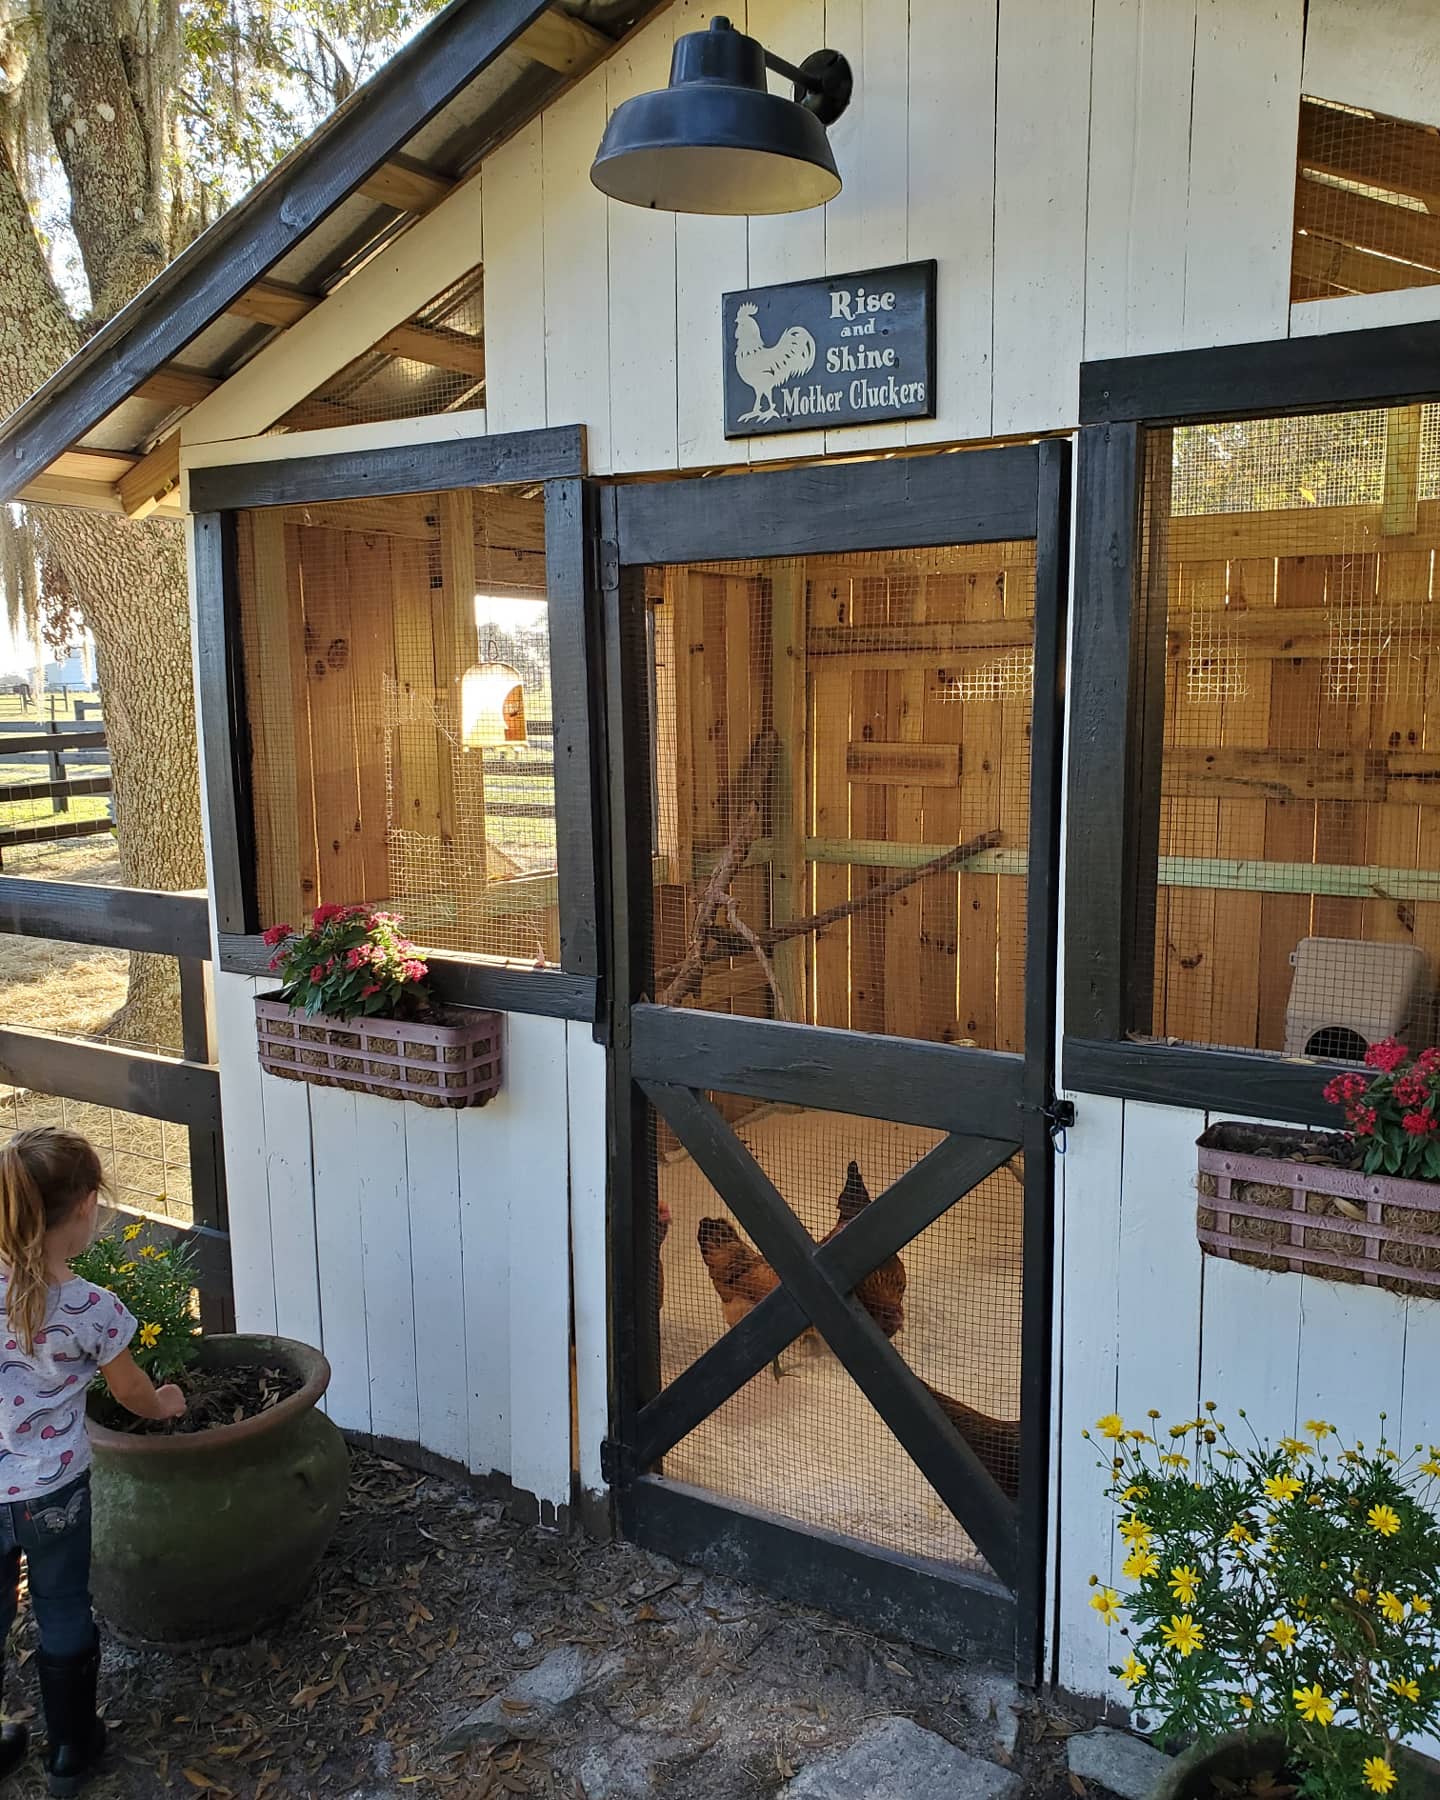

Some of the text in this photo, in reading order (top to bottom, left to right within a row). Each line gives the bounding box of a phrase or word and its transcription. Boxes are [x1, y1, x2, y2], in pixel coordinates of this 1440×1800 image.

[829, 288, 896, 321] Rise
[840, 318, 876, 338] and
[826, 344, 896, 373] Shine
[781, 376, 925, 417] Mother Cluckers
